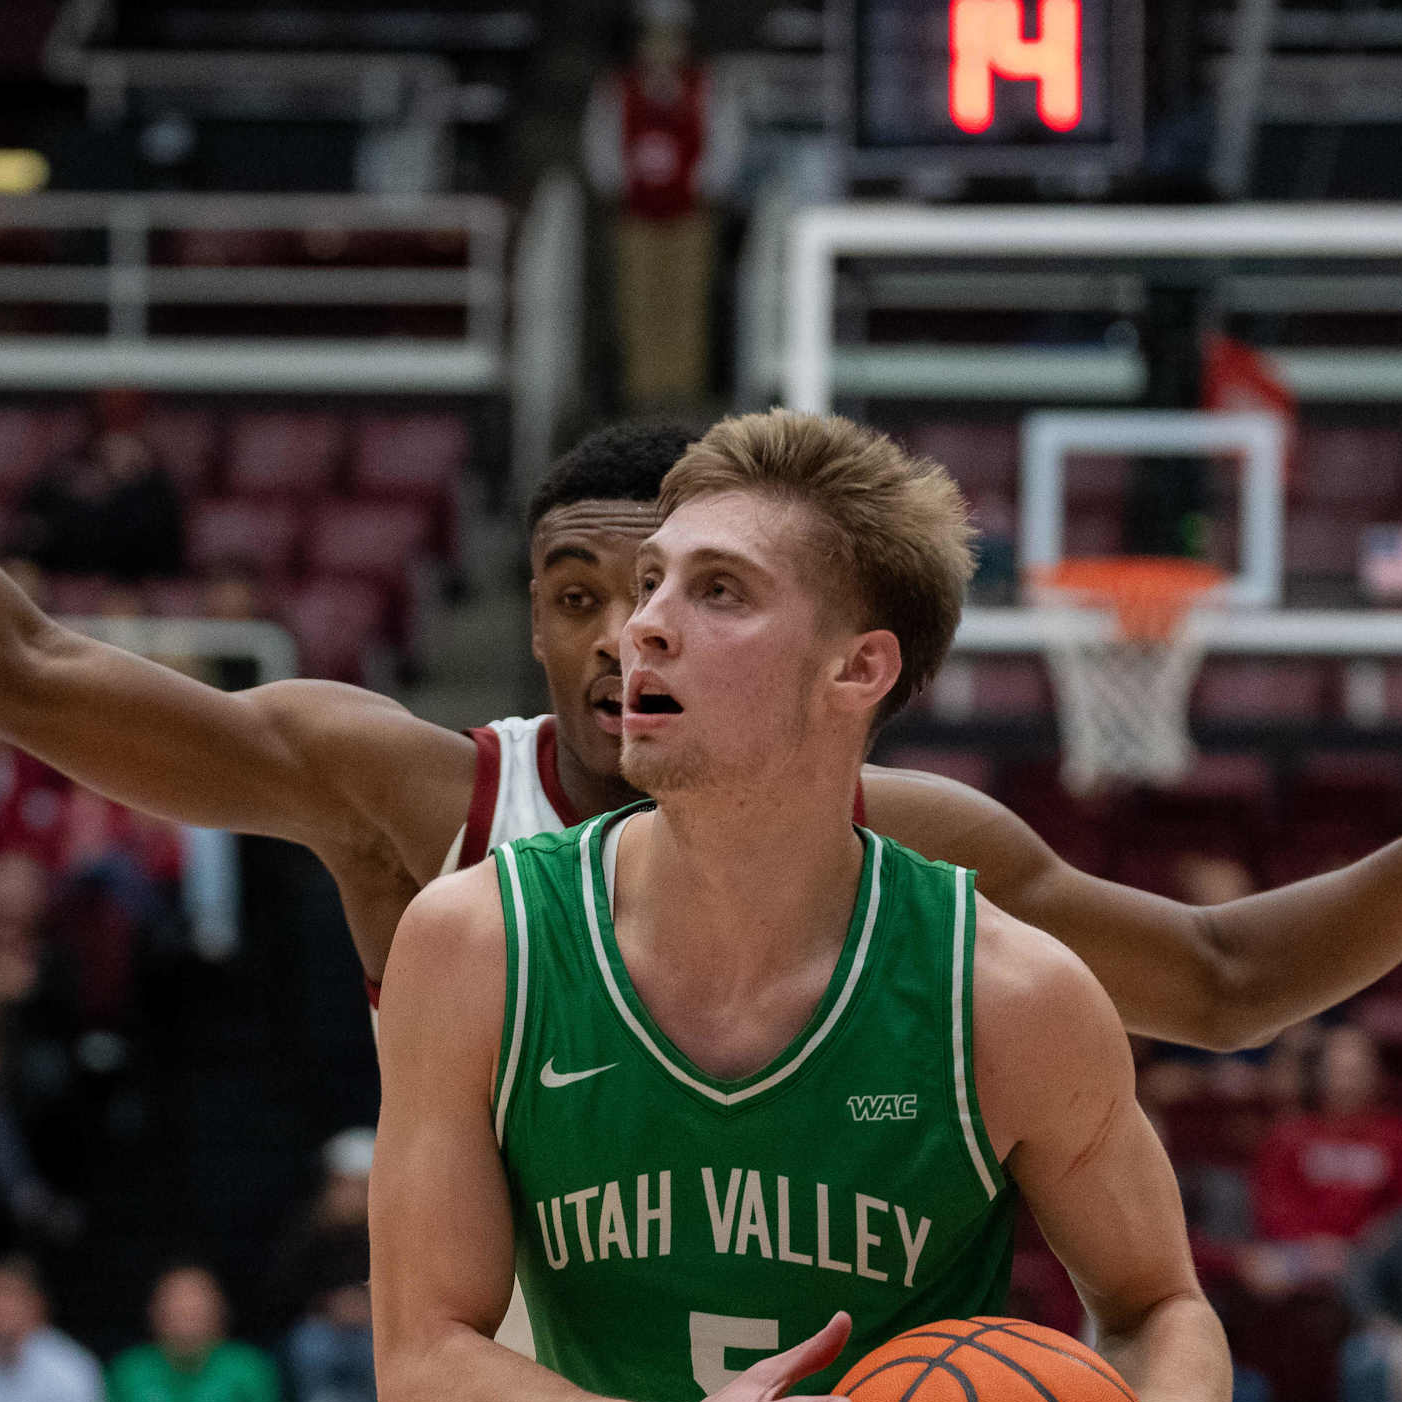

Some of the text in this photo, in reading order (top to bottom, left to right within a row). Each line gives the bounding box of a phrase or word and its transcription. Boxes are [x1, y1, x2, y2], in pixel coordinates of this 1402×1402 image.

[949, 0, 1082, 133] 14
[846, 1094, 917, 1121] WAC
[536, 1167, 932, 1288] UTAH VALLEY
